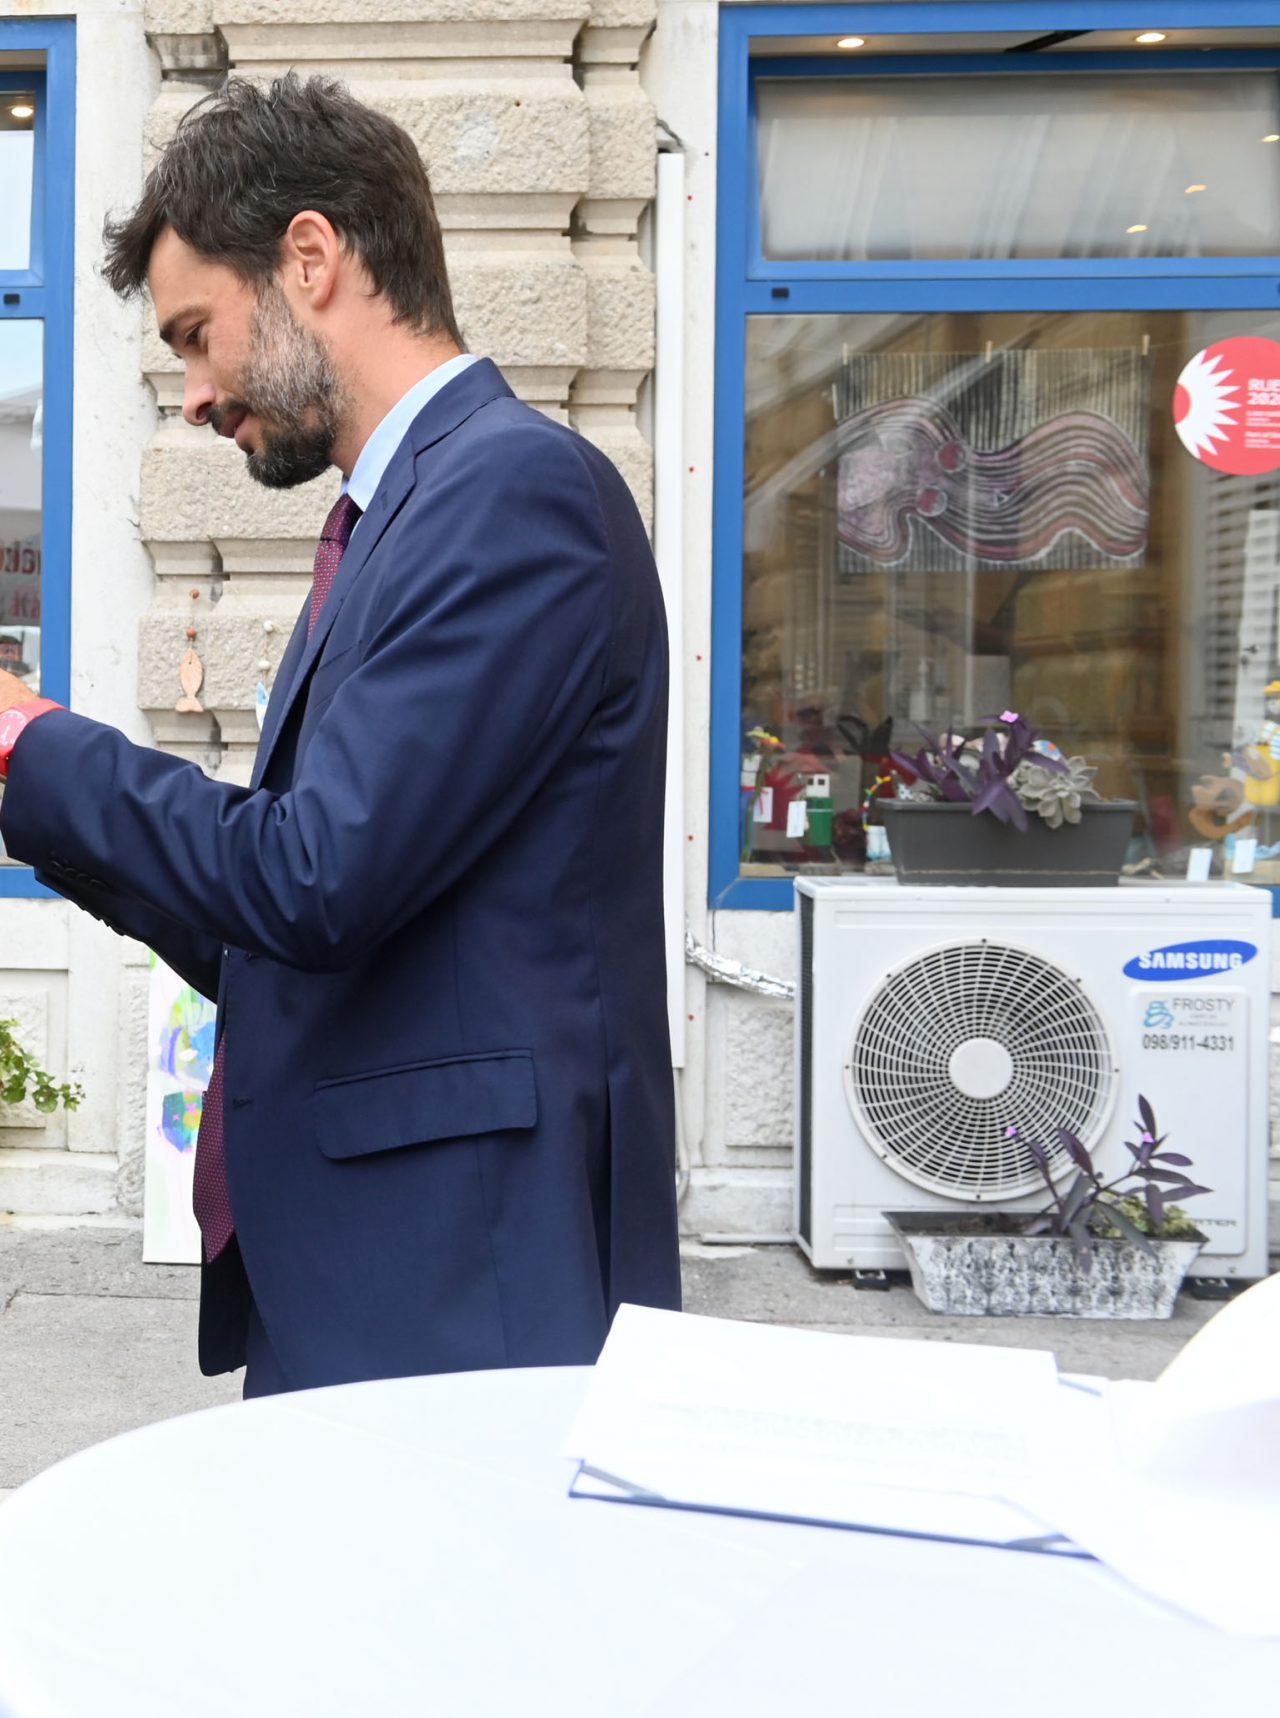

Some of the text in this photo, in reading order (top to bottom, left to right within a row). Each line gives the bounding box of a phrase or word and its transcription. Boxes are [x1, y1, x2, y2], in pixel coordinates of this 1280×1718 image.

[1247, 378, 1280, 391] RIJE
[1138, 952, 1243, 970] SAMSUNG
[1173, 998, 1235, 1011] FROSTY
